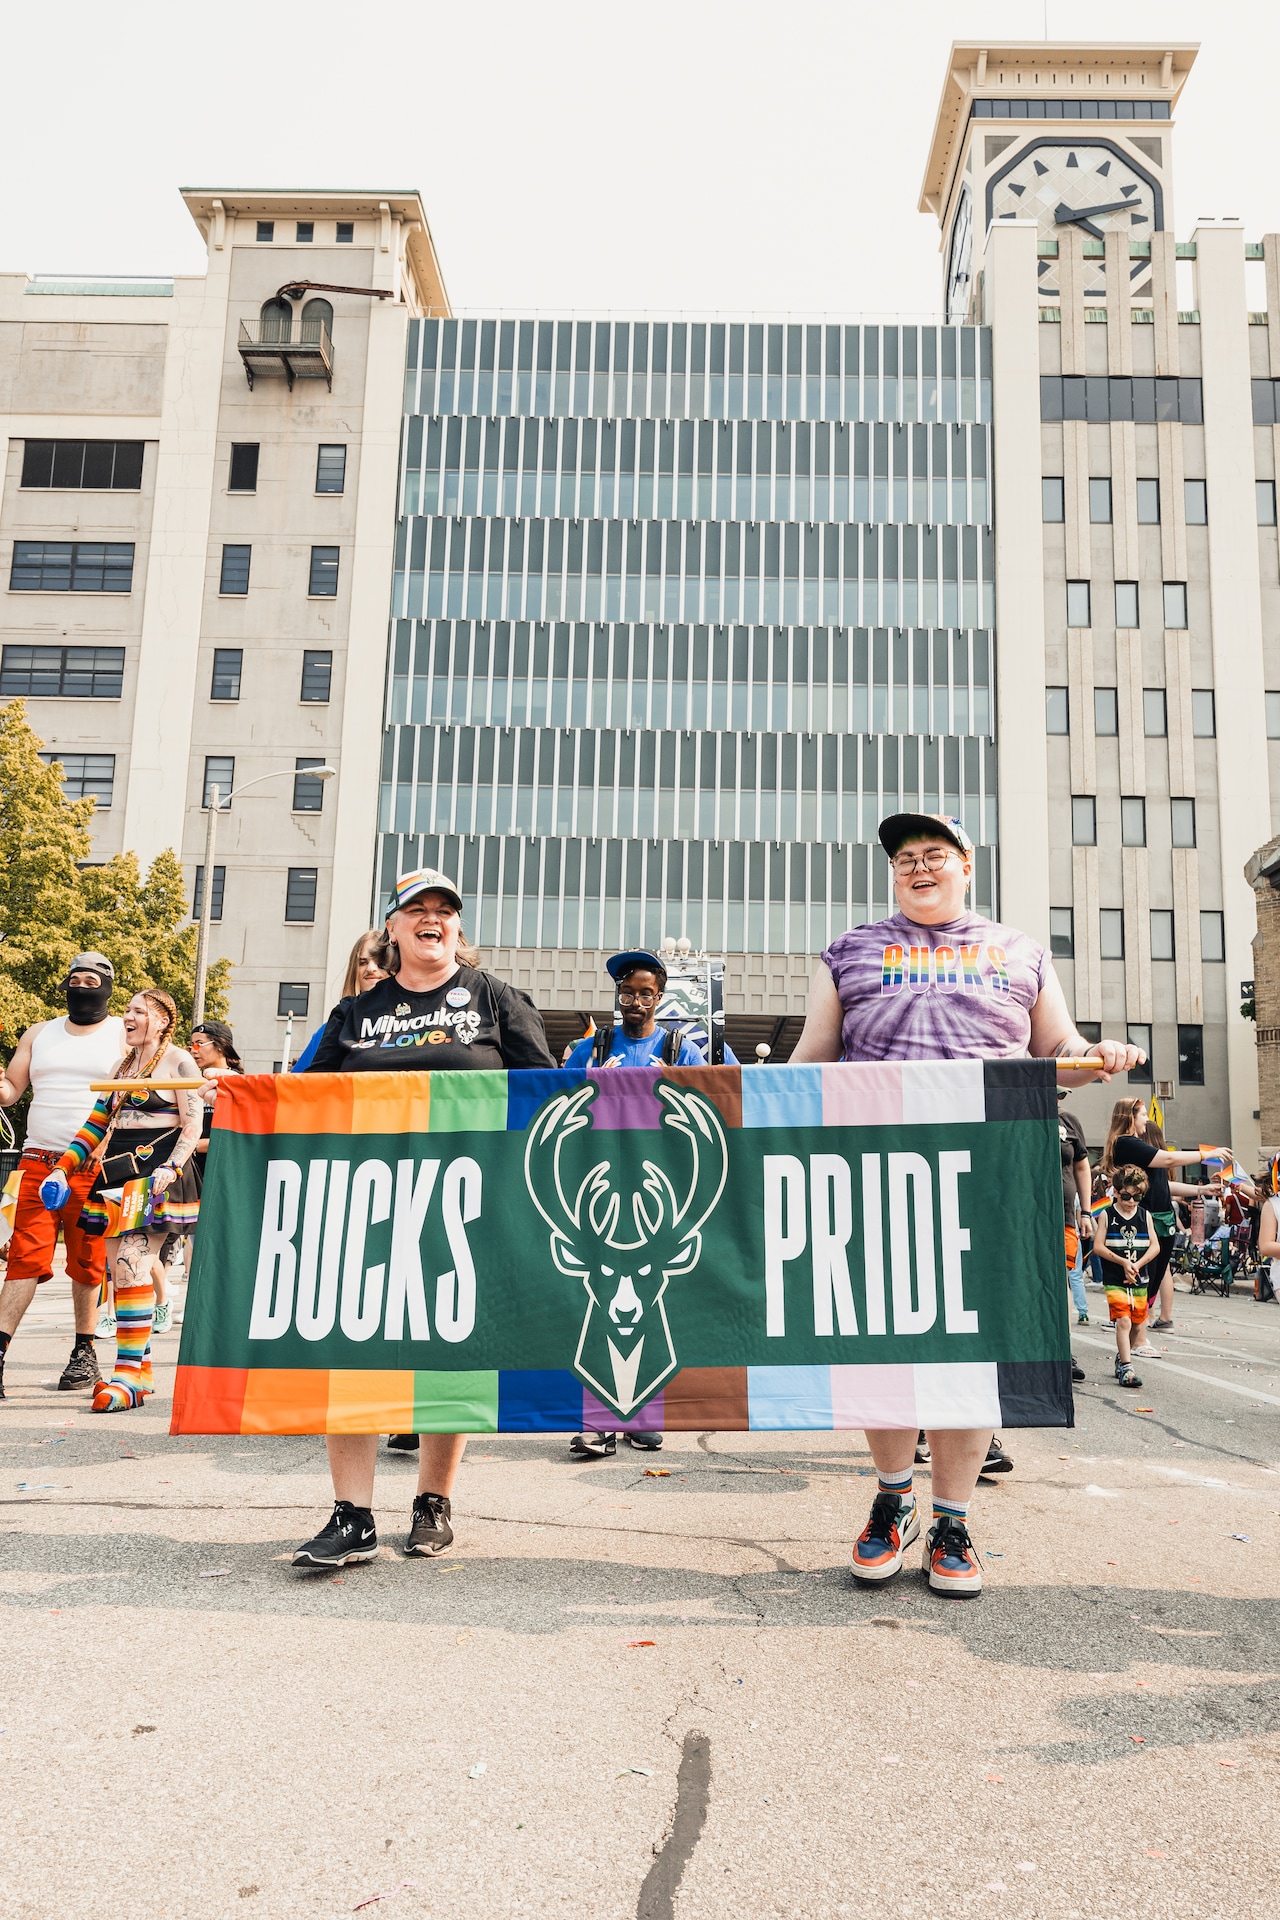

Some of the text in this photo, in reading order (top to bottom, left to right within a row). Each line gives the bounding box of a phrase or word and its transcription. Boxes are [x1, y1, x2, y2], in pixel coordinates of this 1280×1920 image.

[880, 943, 1010, 1001] BUCKS
[360, 1006, 481, 1038] Milwaukee
[350, 1029, 452, 1049] is Love.
[122, 1195, 131, 1217] PRIDE
[128, 1190, 138, 1219] PARADE
[248, 1150, 979, 1343] BUCKS PRIDE
[1123, 1249, 1138, 1263] 34
